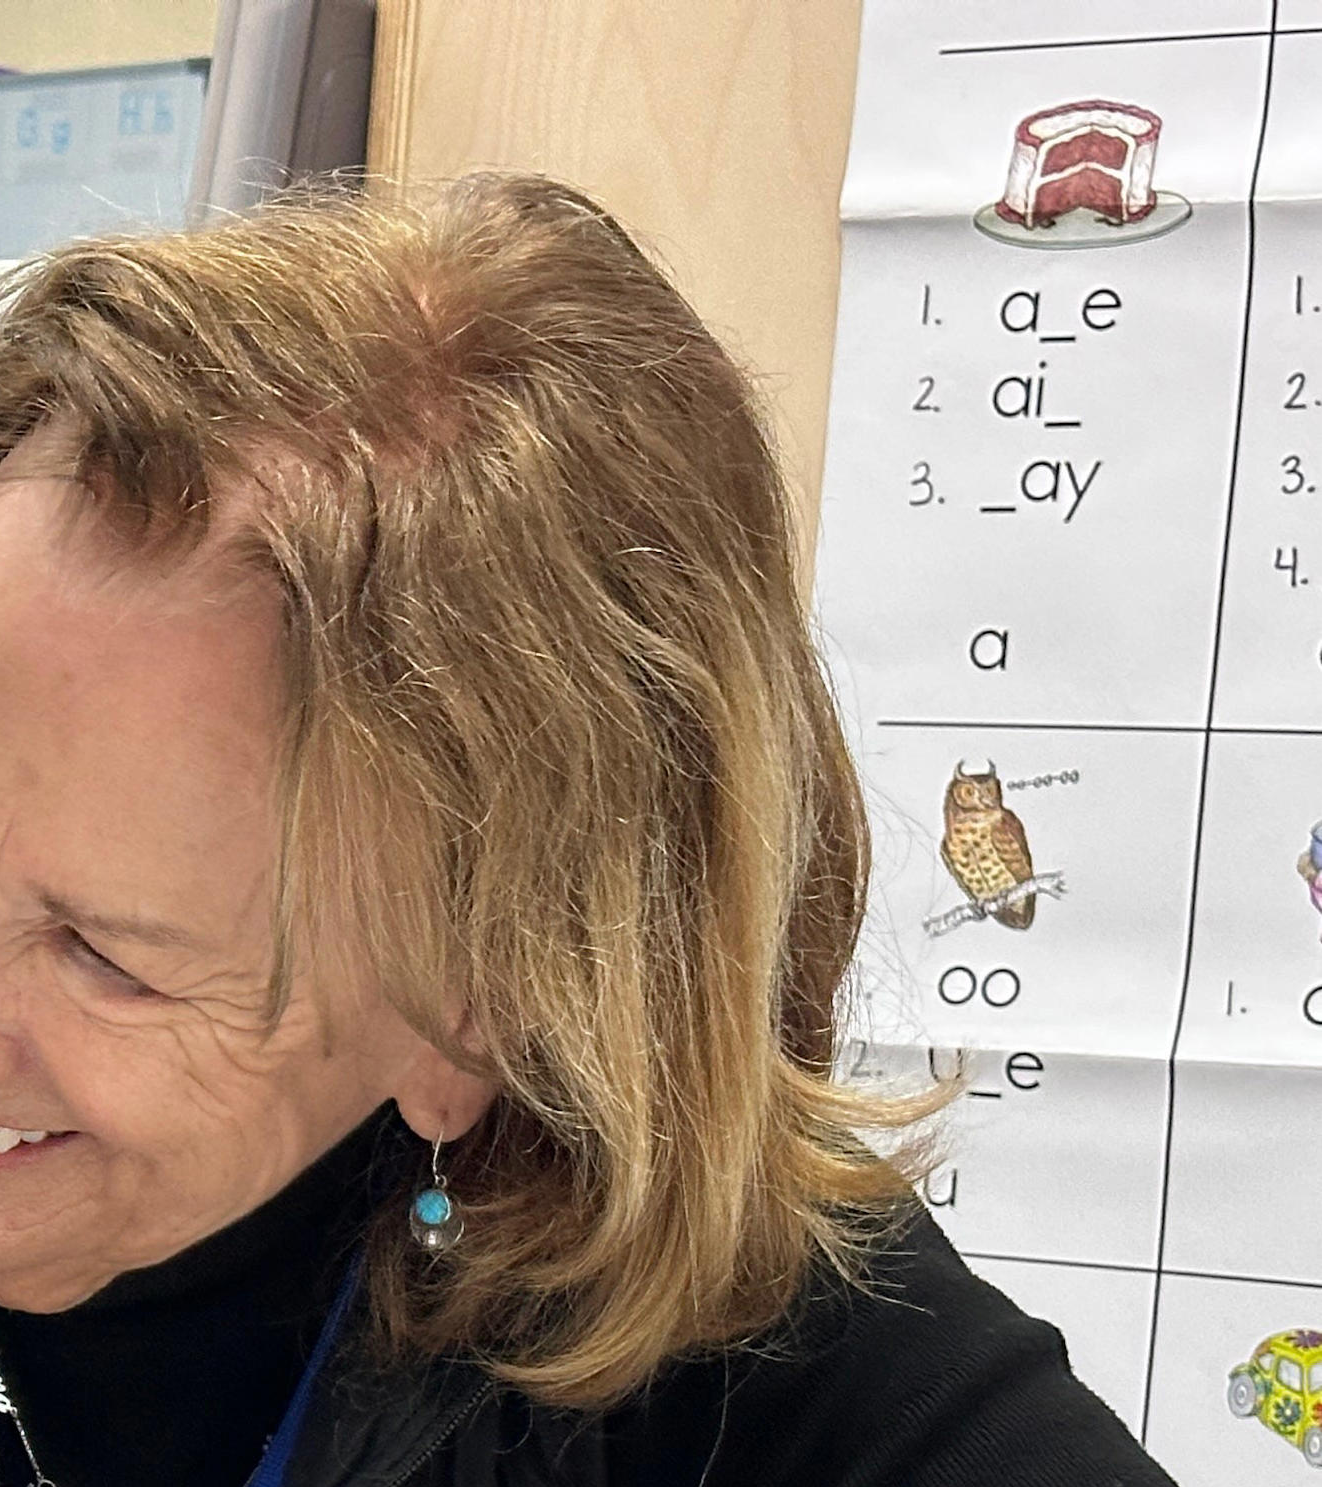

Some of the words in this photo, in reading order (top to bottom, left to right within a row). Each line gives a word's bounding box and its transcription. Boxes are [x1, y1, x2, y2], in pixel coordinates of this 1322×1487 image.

[919, 284, 943, 328] 1.
[998, 287, 1123, 345] a_e
[1294, 276, 1322, 316] 1.
[911, 376, 941, 414] 2.
[992, 361, 1082, 428] ai_
[1283, 372, 1322, 411] 2.
[908, 461, 947, 507] 3.
[979, 459, 1103, 524] _ay
[1279, 456, 1317, 496] 3.
[1273, 547, 1309, 588] 4.
[969, 628, 1009, 672] a
[937, 966, 1022, 1008] oo
[1226, 980, 1248, 1017] 1.
